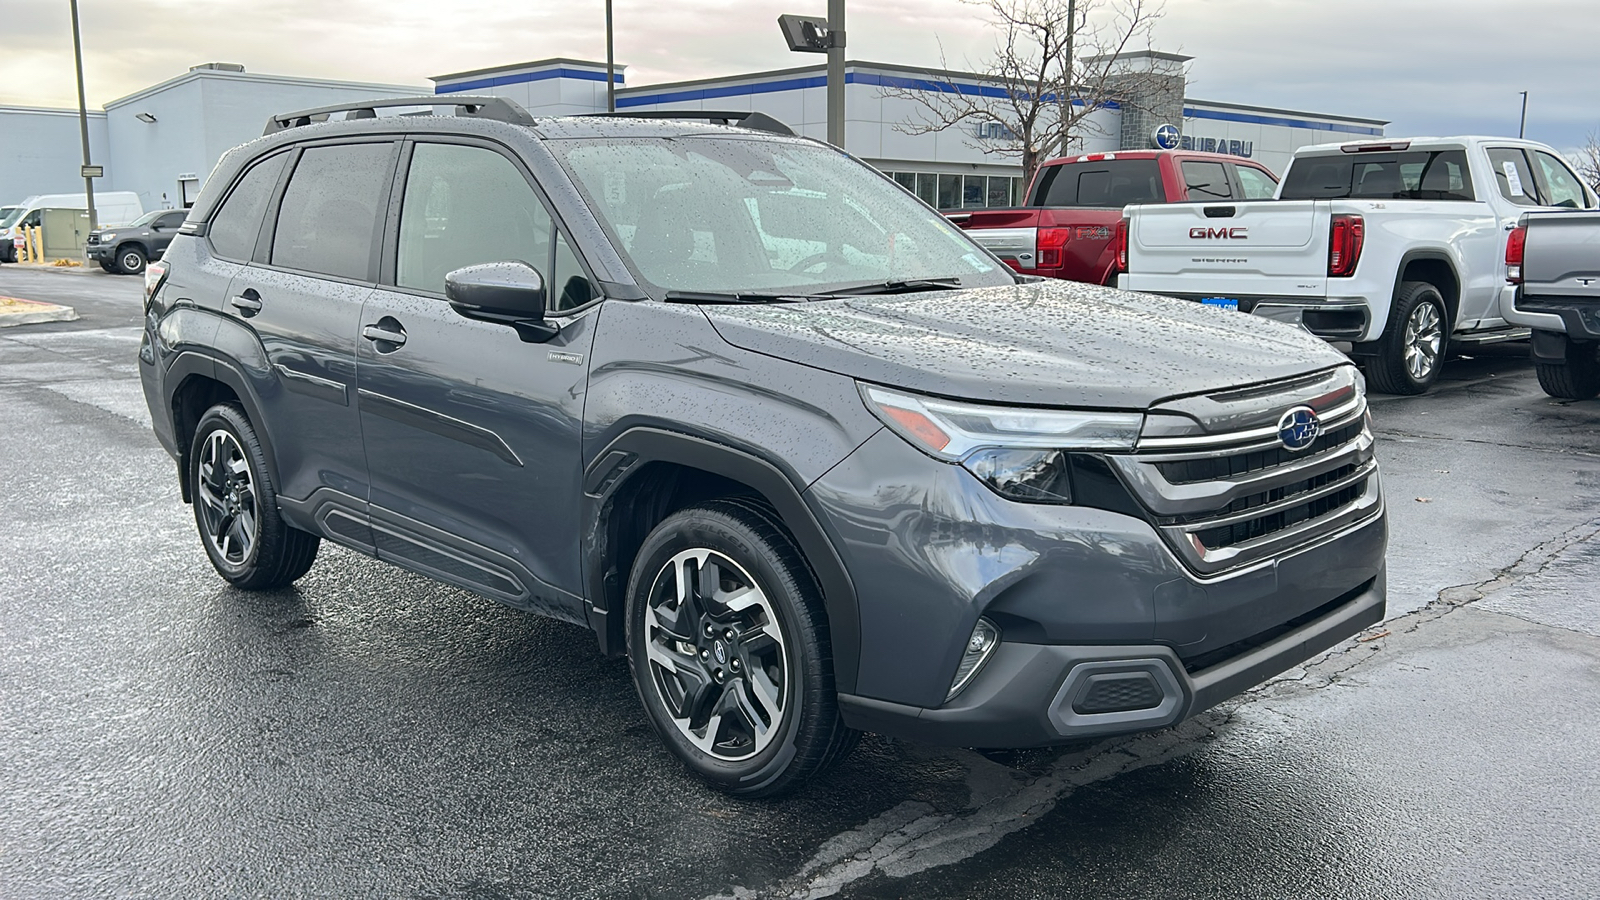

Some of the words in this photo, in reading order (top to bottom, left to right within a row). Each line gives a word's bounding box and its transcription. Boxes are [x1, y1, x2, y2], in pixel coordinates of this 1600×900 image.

[1181, 135, 1253, 158] SUBARU
[1076, 226, 1109, 240] FX4
[1188, 227, 1249, 239] GMC
[552, 353, 576, 362] HYBRID
